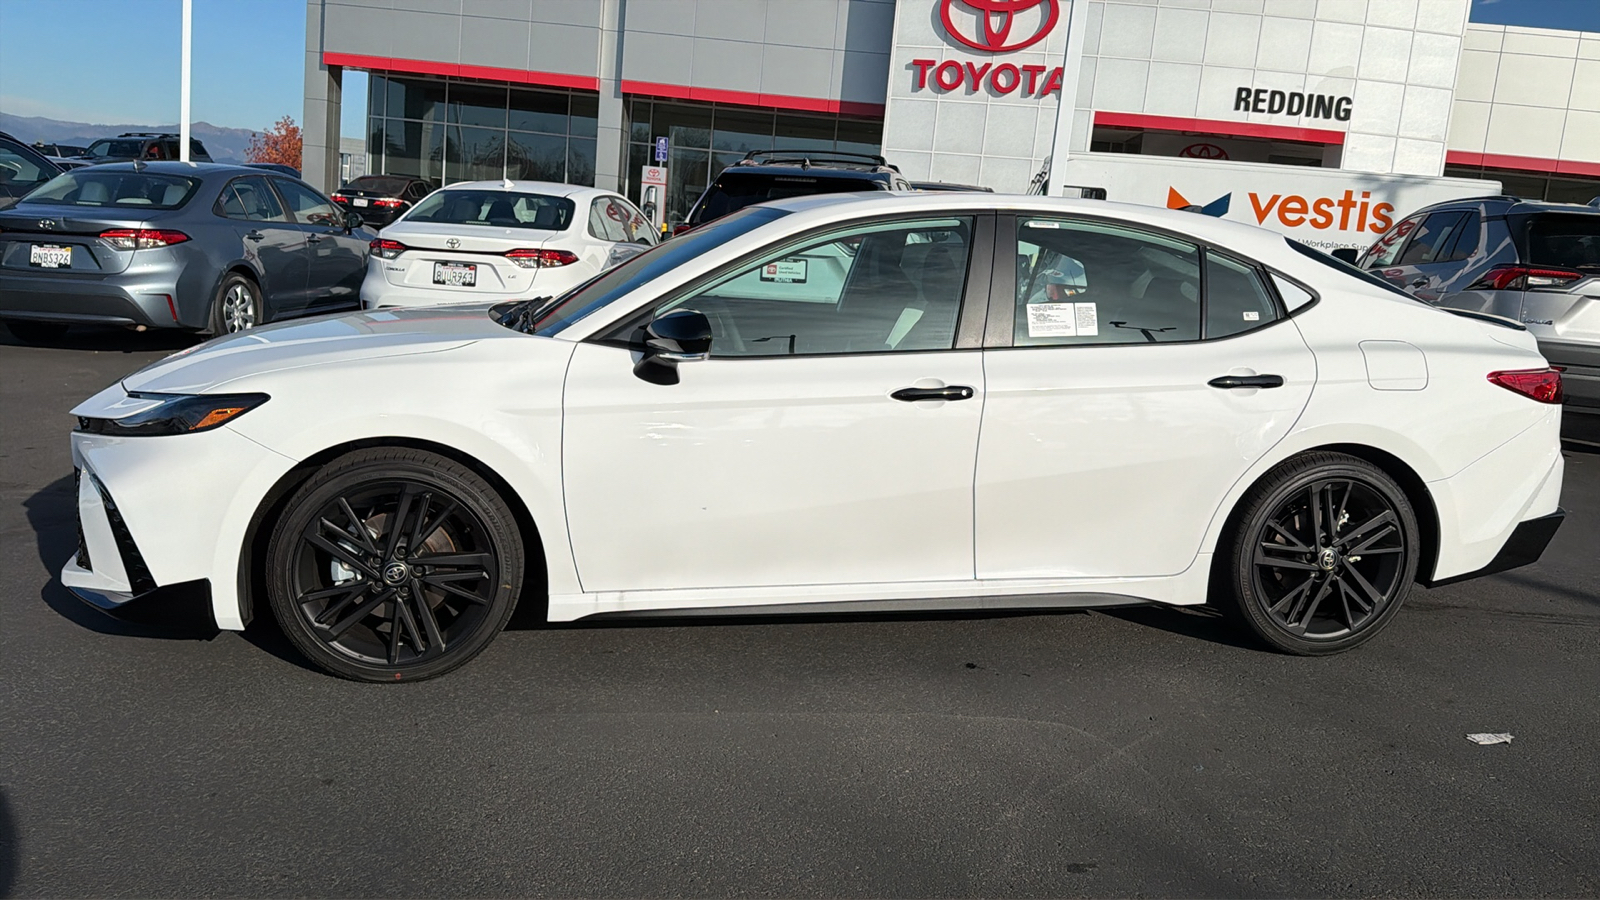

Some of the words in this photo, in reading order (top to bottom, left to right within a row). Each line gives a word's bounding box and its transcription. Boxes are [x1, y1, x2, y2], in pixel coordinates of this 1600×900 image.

[912, 59, 1063, 95] TOYOTA
[1234, 86, 1353, 122] REDDING
[1248, 190, 1395, 234] vestis
[33, 252, 69, 264] 8NBS326
[1302, 239, 1349, 250] Workplace
[1351, 242, 1372, 252] Sup
